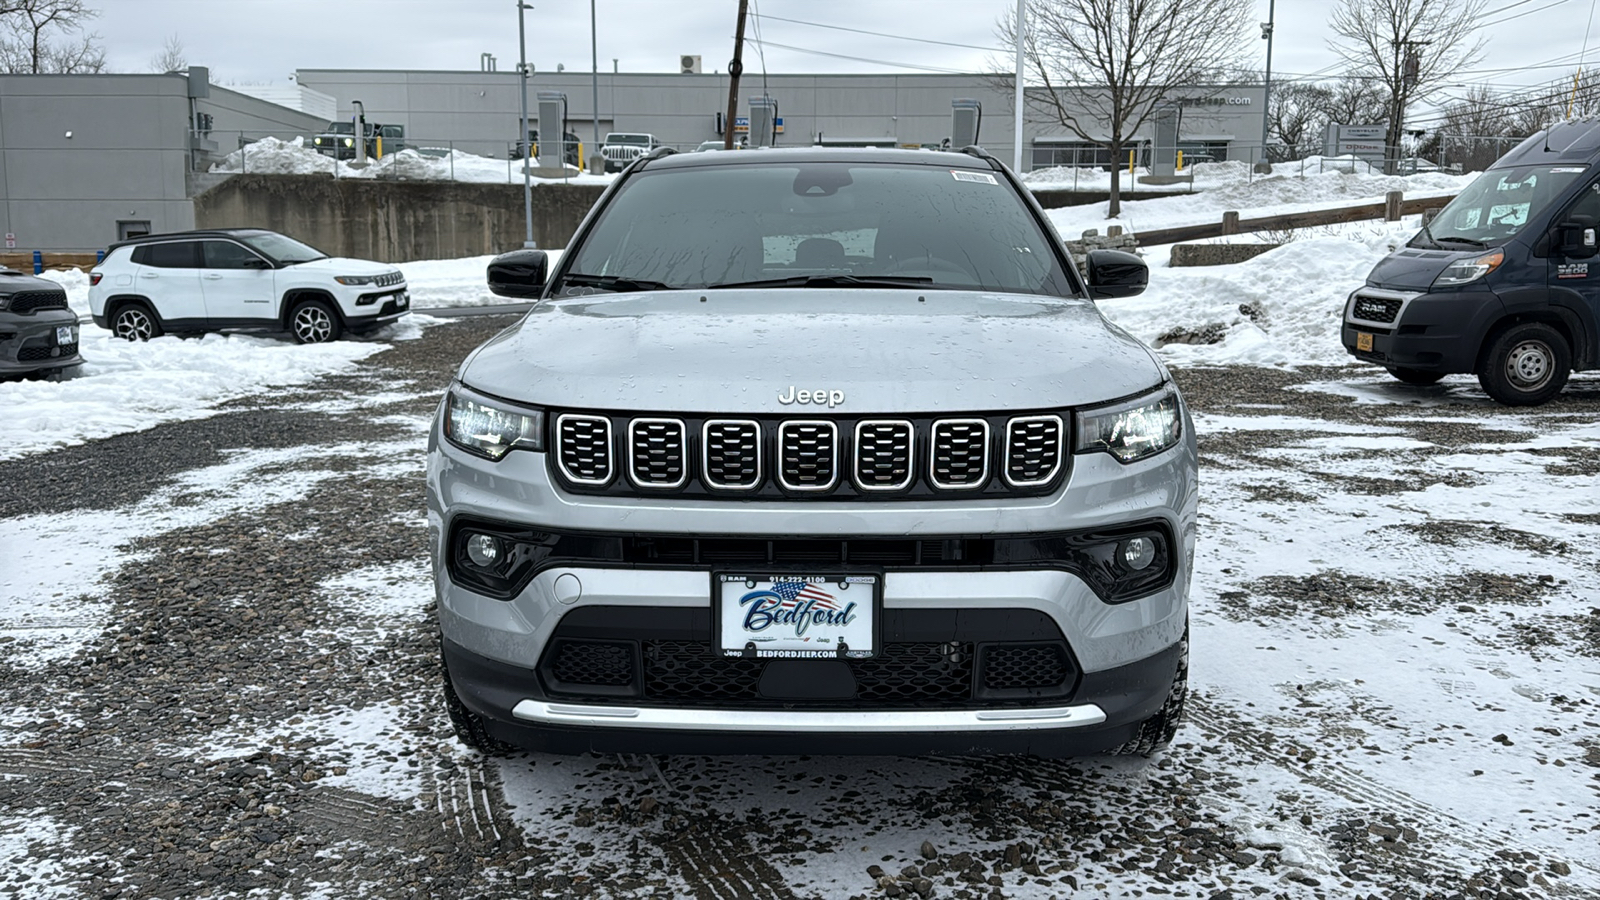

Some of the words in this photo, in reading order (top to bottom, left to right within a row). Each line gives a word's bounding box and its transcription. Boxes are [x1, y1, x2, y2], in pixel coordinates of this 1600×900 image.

[1361, 303, 1386, 313] RAM
[778, 385, 845, 408] Jeep
[739, 590, 857, 637] Bedford
[723, 650, 743, 658] Jeep
[756, 650, 838, 658] BEDFORDJEEP.COM
